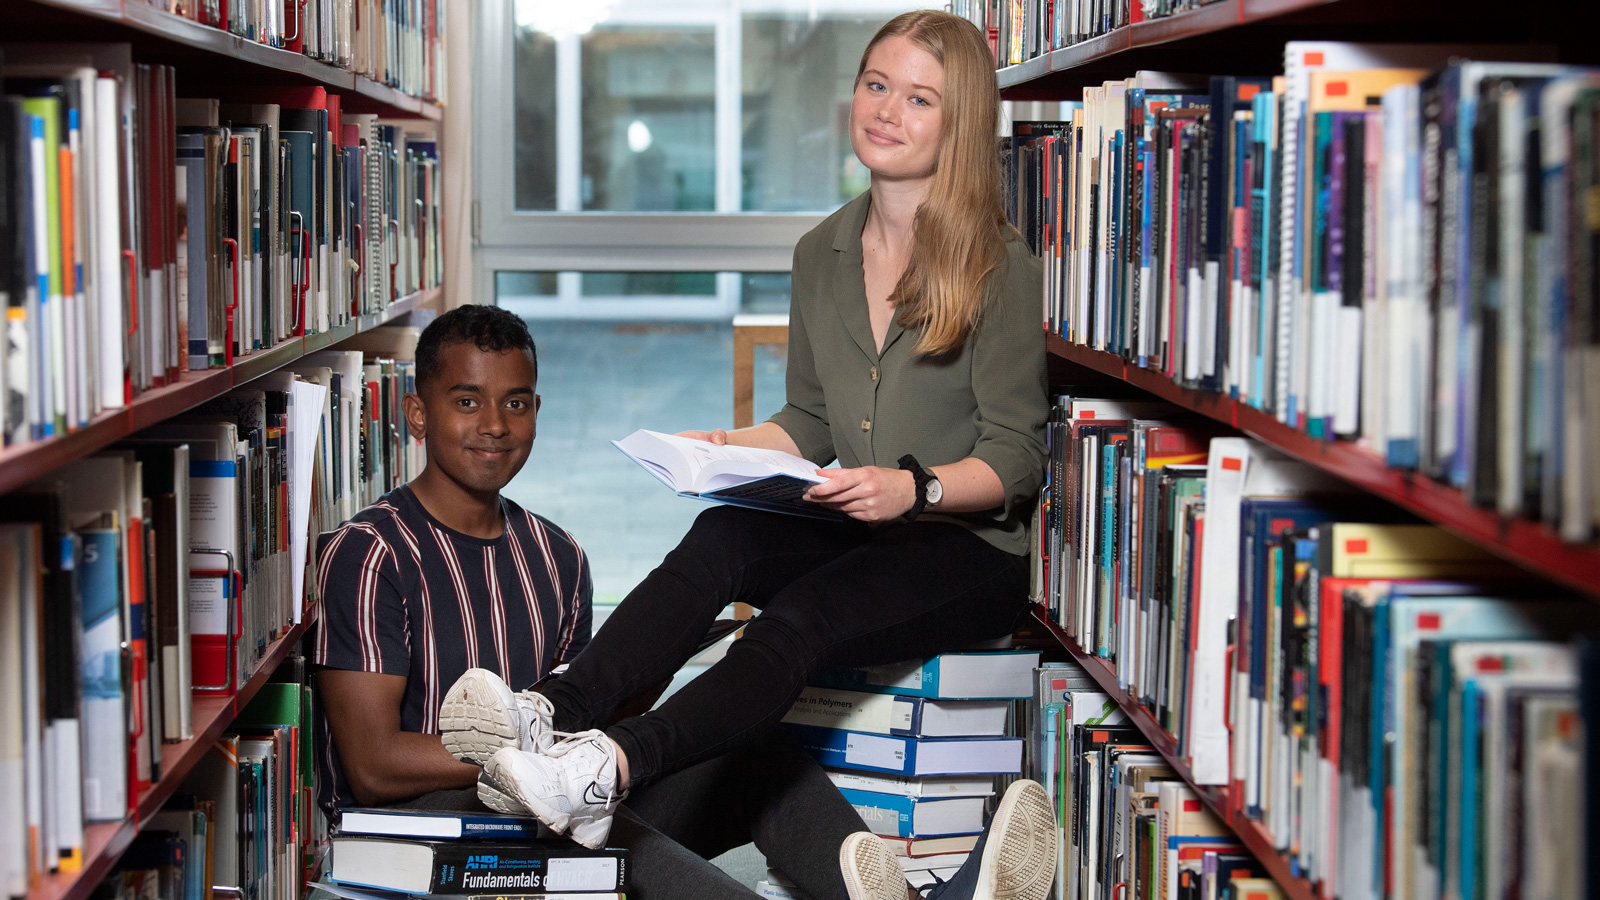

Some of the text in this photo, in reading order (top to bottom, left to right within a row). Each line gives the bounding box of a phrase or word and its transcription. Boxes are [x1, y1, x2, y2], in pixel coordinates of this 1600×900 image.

[809, 696, 817, 704] in
[818, 697, 853, 708] Polymers
[856, 805, 883, 822] rials
[1116, 812, 1122, 826] RF
[465, 855, 498, 869] AHRI
[462, 871, 540, 889] Fundamentals
